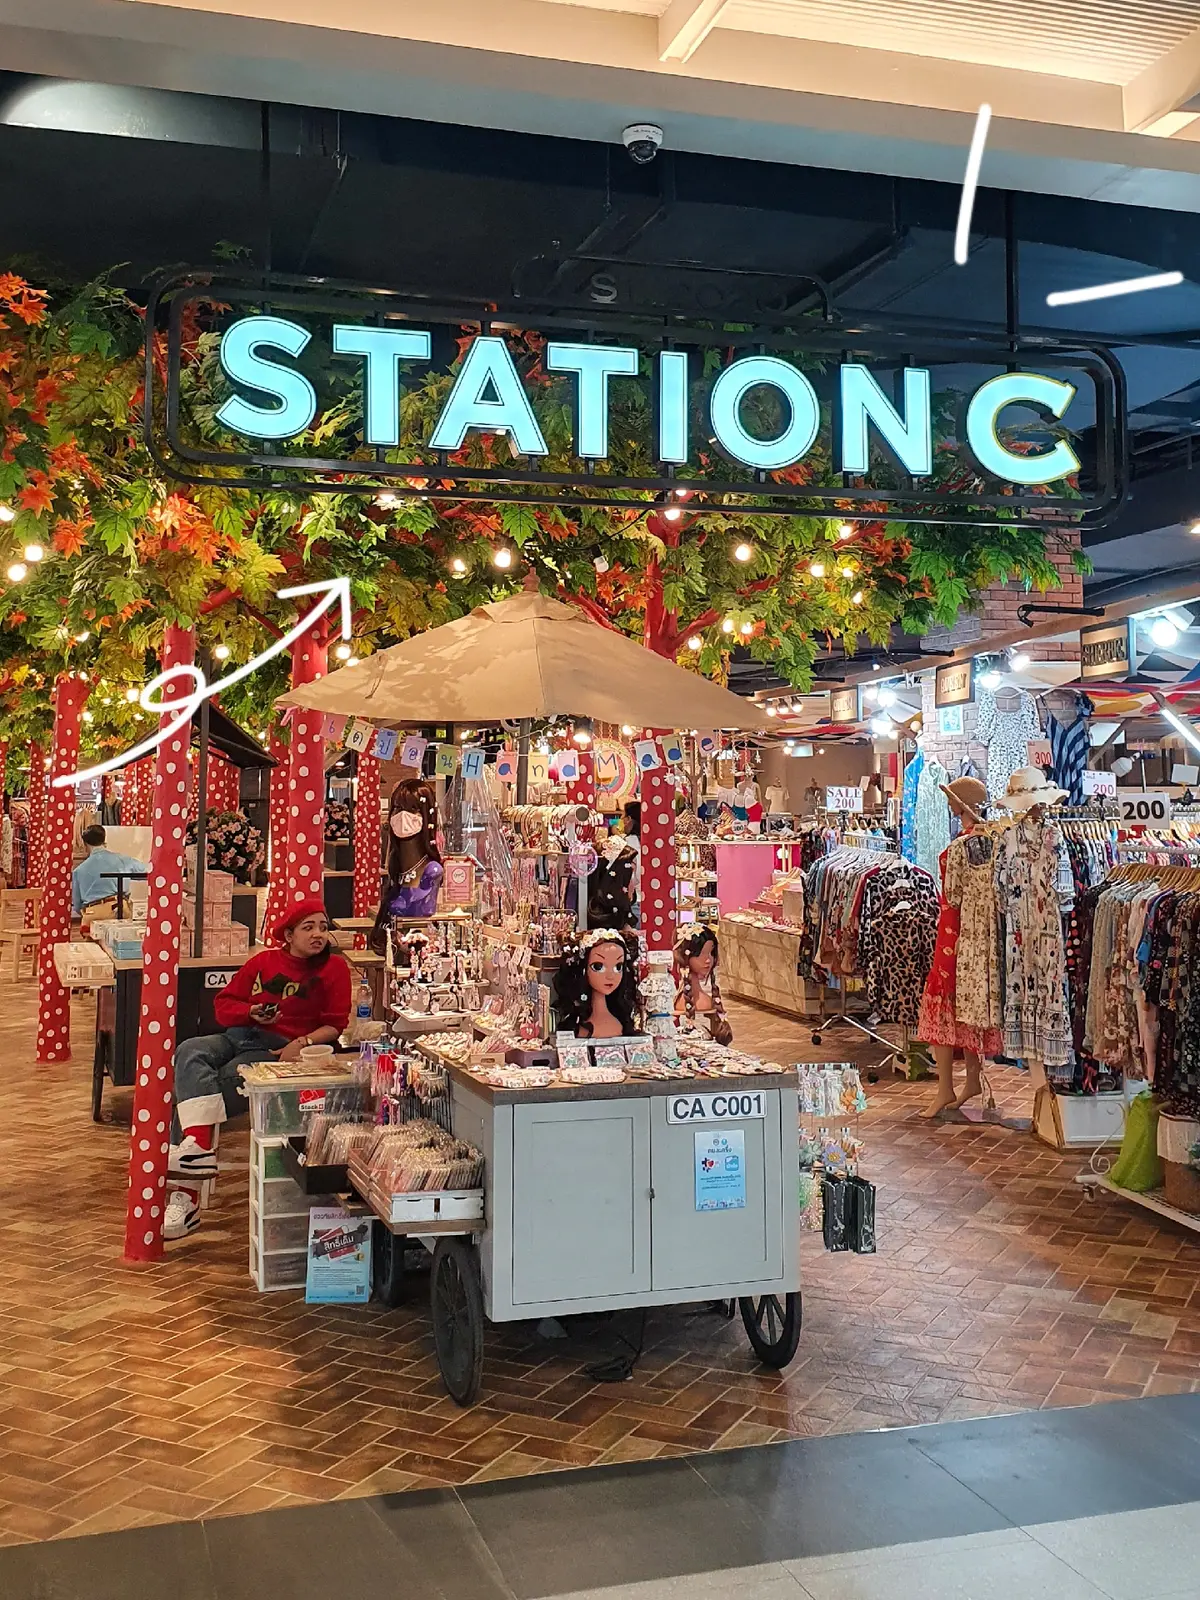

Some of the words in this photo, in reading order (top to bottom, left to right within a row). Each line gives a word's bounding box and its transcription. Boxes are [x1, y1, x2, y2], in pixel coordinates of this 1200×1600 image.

[214, 315, 933, 476] STATION
[966, 371, 1083, 486] C
[1035, 751, 1052, 765] 300
[827, 787, 862, 799] SALE
[1092, 783, 1115, 796] 200
[834, 798, 855, 809] 200
[1122, 799, 1165, 821] 200
[208, 974, 227, 985] CA
[673, 1097, 706, 1120] CA
[711, 1094, 762, 1117] C001
